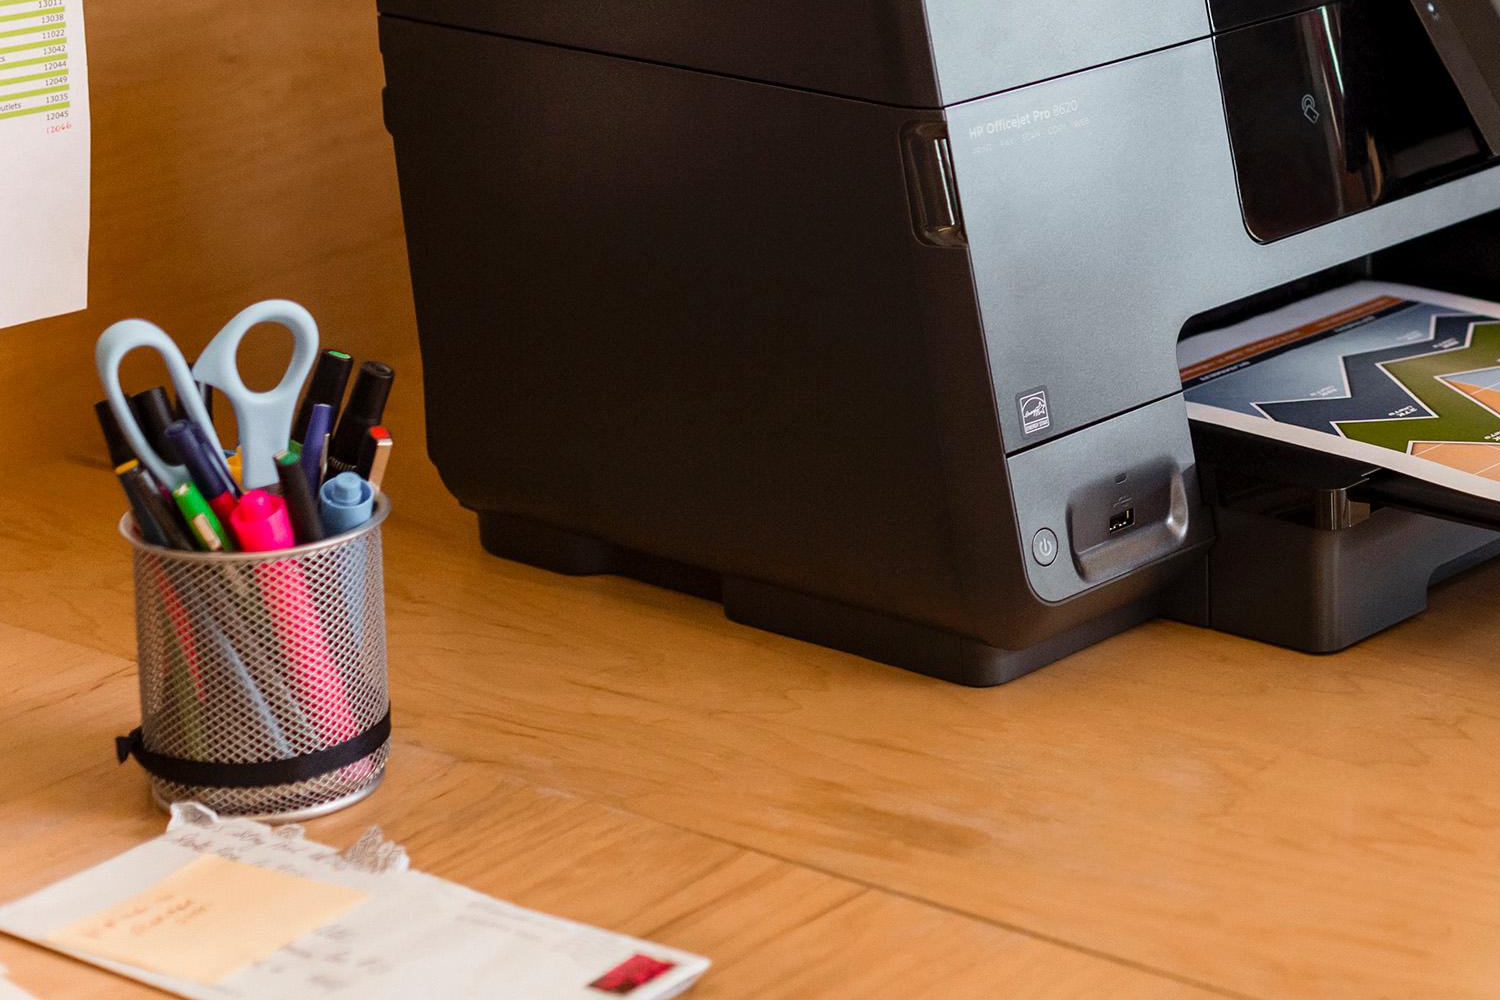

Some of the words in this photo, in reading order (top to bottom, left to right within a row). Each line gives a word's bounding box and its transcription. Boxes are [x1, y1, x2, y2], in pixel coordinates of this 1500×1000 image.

[42, 14, 64, 24] 13038
[42, 29, 65, 39] 11022
[44, 45, 66, 55] 13042
[44, 61, 67, 71] 12044
[45, 76, 67, 86] 12049
[0, 103, 21, 111] utlets
[46, 93, 68, 103] 13035
[46, 111, 69, 121] 12045
[969, 126, 984, 139] HP
[1032, 109, 1050, 121] Pro
